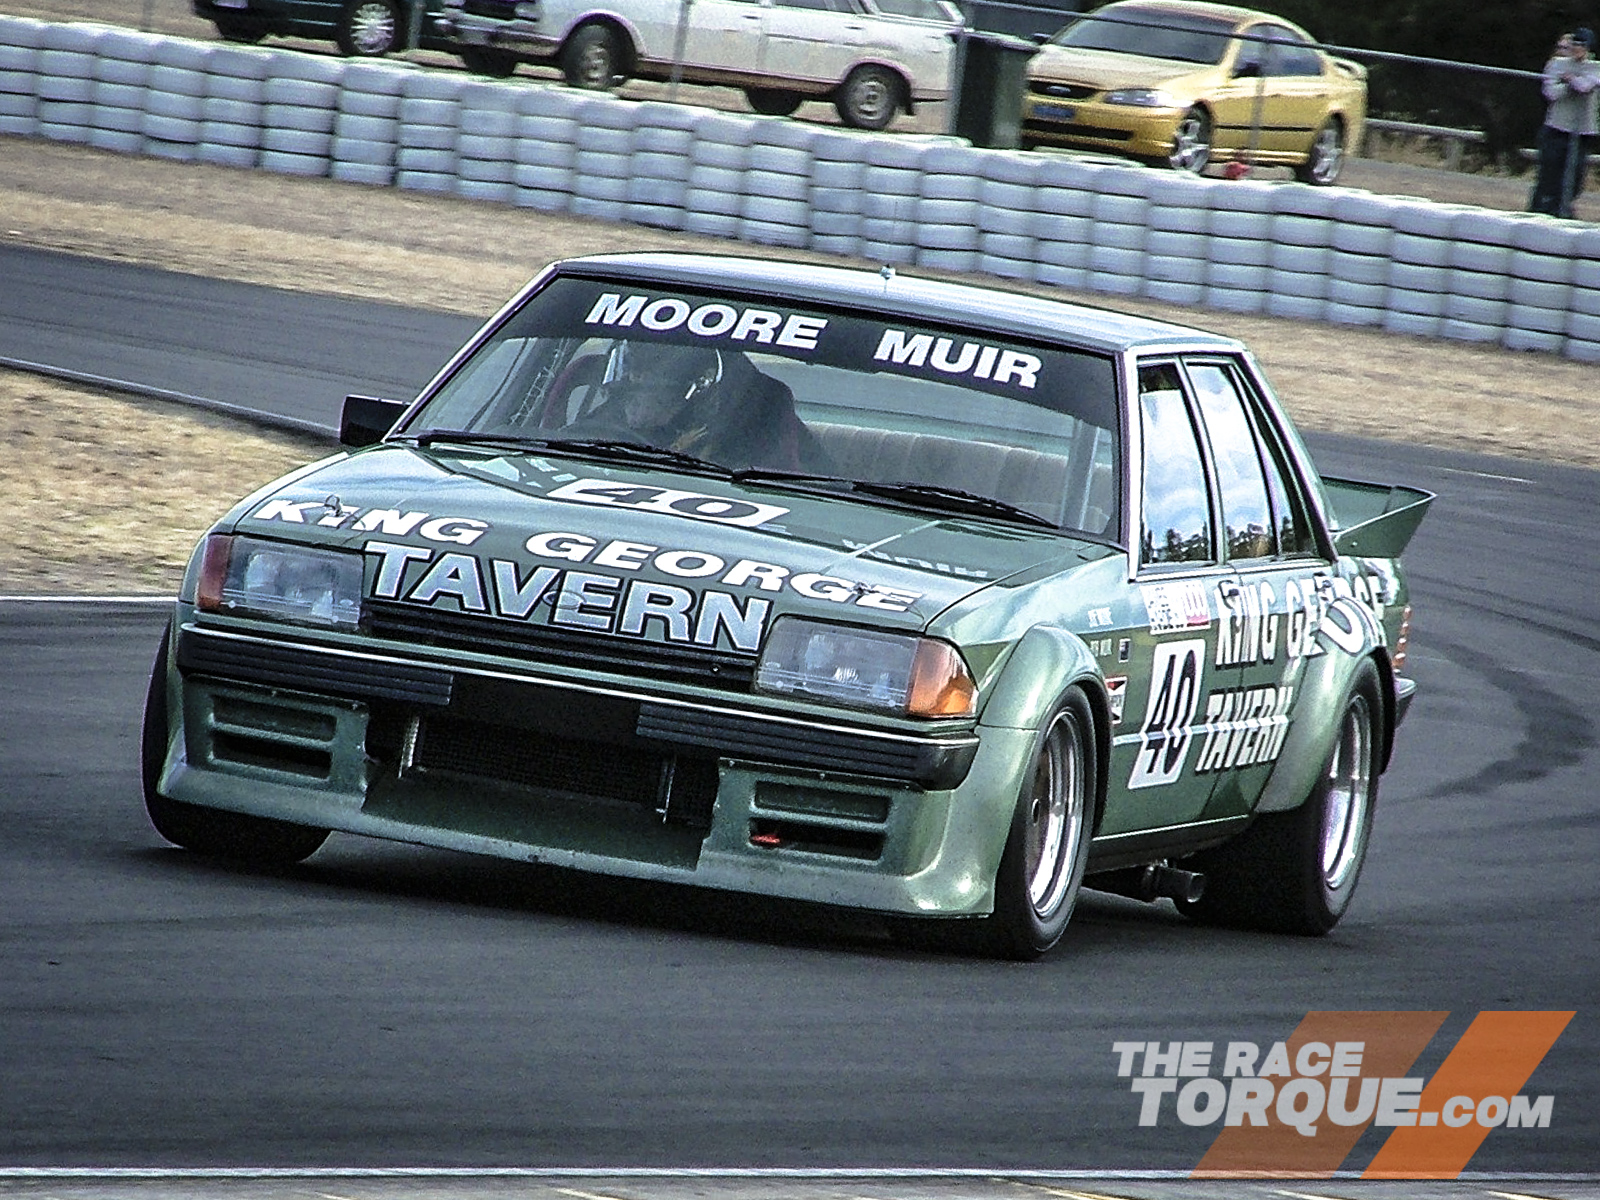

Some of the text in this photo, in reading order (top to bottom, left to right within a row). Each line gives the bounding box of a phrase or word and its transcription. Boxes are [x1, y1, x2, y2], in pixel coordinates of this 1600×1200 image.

[585, 293, 1043, 388] MOORE MUIR
[574, 483, 761, 521] 40
[253, 500, 489, 545] KING
[525, 532, 924, 612] GEORGE
[363, 541, 771, 655] TAVERN
[1214, 580, 1278, 666] KING
[1144, 649, 1197, 775] 40
[1194, 685, 1294, 773] TAVERN
